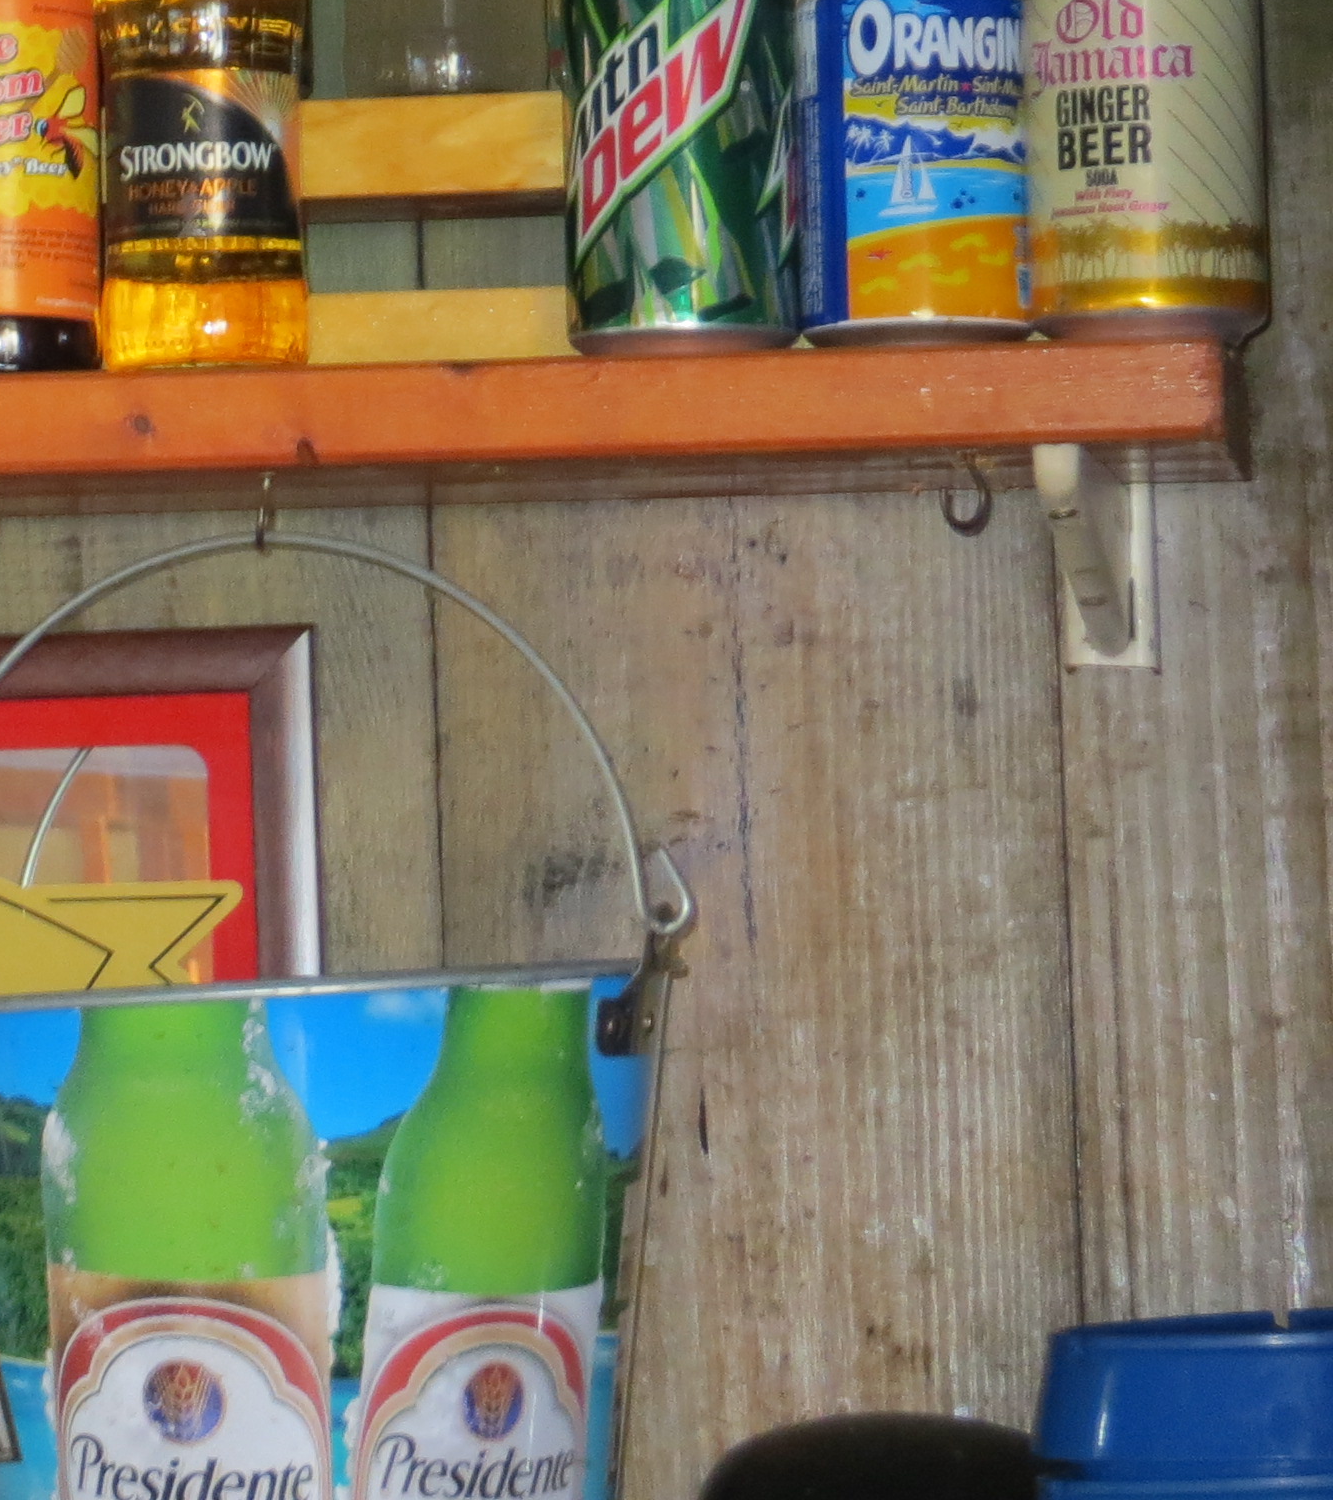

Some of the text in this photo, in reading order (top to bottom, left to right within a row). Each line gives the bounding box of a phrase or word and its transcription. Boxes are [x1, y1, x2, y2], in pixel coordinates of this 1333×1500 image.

[849, 73, 960, 98] Saint-Martin
[1031, 40, 1196, 100] Jamaica
[1055, 83, 1151, 128] GINGER
[24, 156, 69, 177] Beer
[119, 140, 275, 181] STRONGBOW
[1057, 122, 1153, 171] BEER
[1085, 166, 1119, 187] SODA
[70, 1432, 577, 1500] Presidente Presidente
